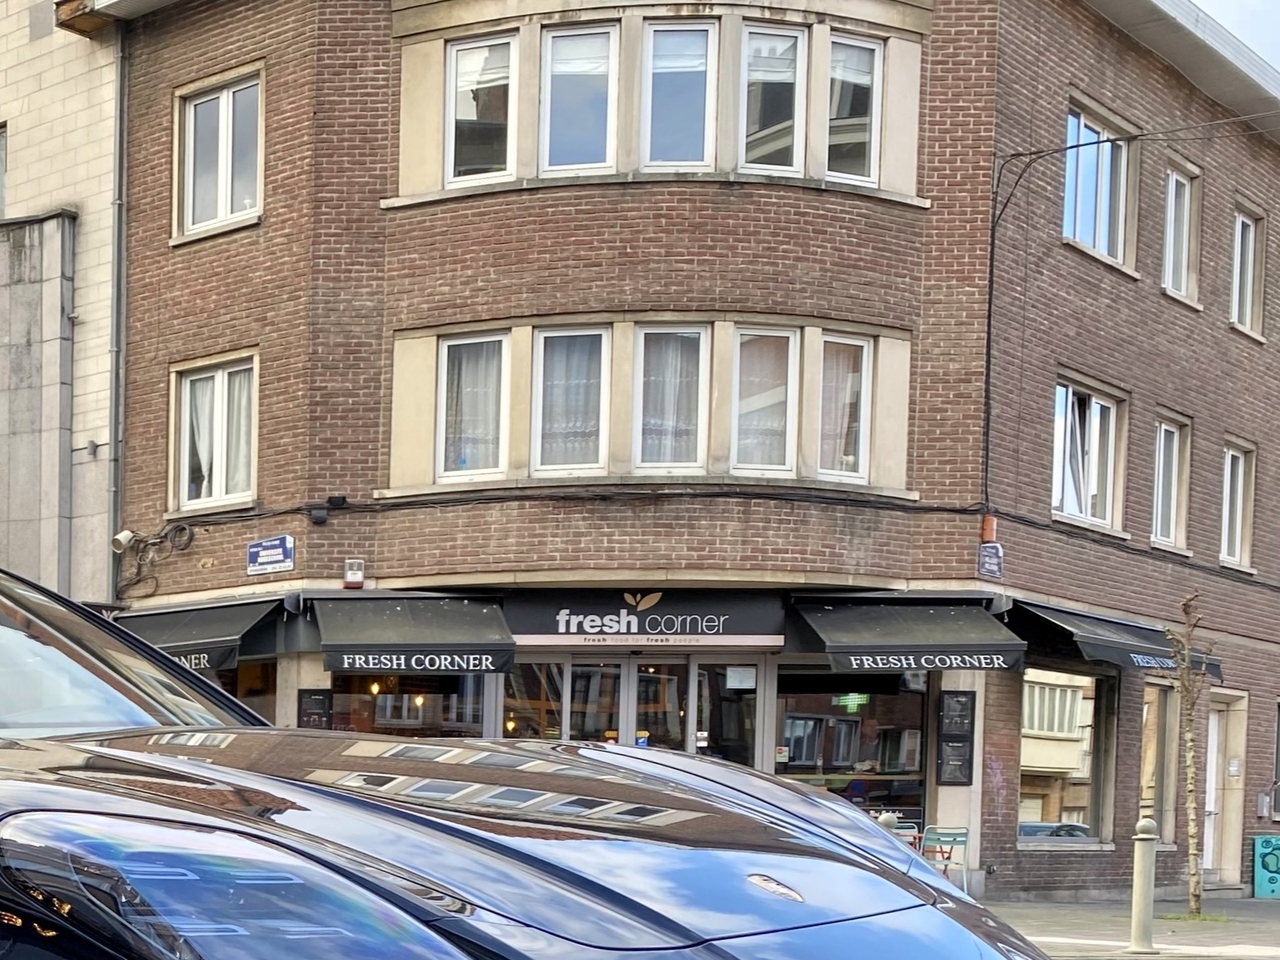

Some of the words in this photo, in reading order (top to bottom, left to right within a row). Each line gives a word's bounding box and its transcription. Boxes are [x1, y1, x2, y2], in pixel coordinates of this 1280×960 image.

[556, 608, 639, 633] fresh
[645, 613, 730, 634] corner
[343, 655, 407, 669] FRESH
[411, 654, 496, 670] CORNER
[849, 655, 916, 670] FRESH
[920, 653, 1008, 669] CORNER
